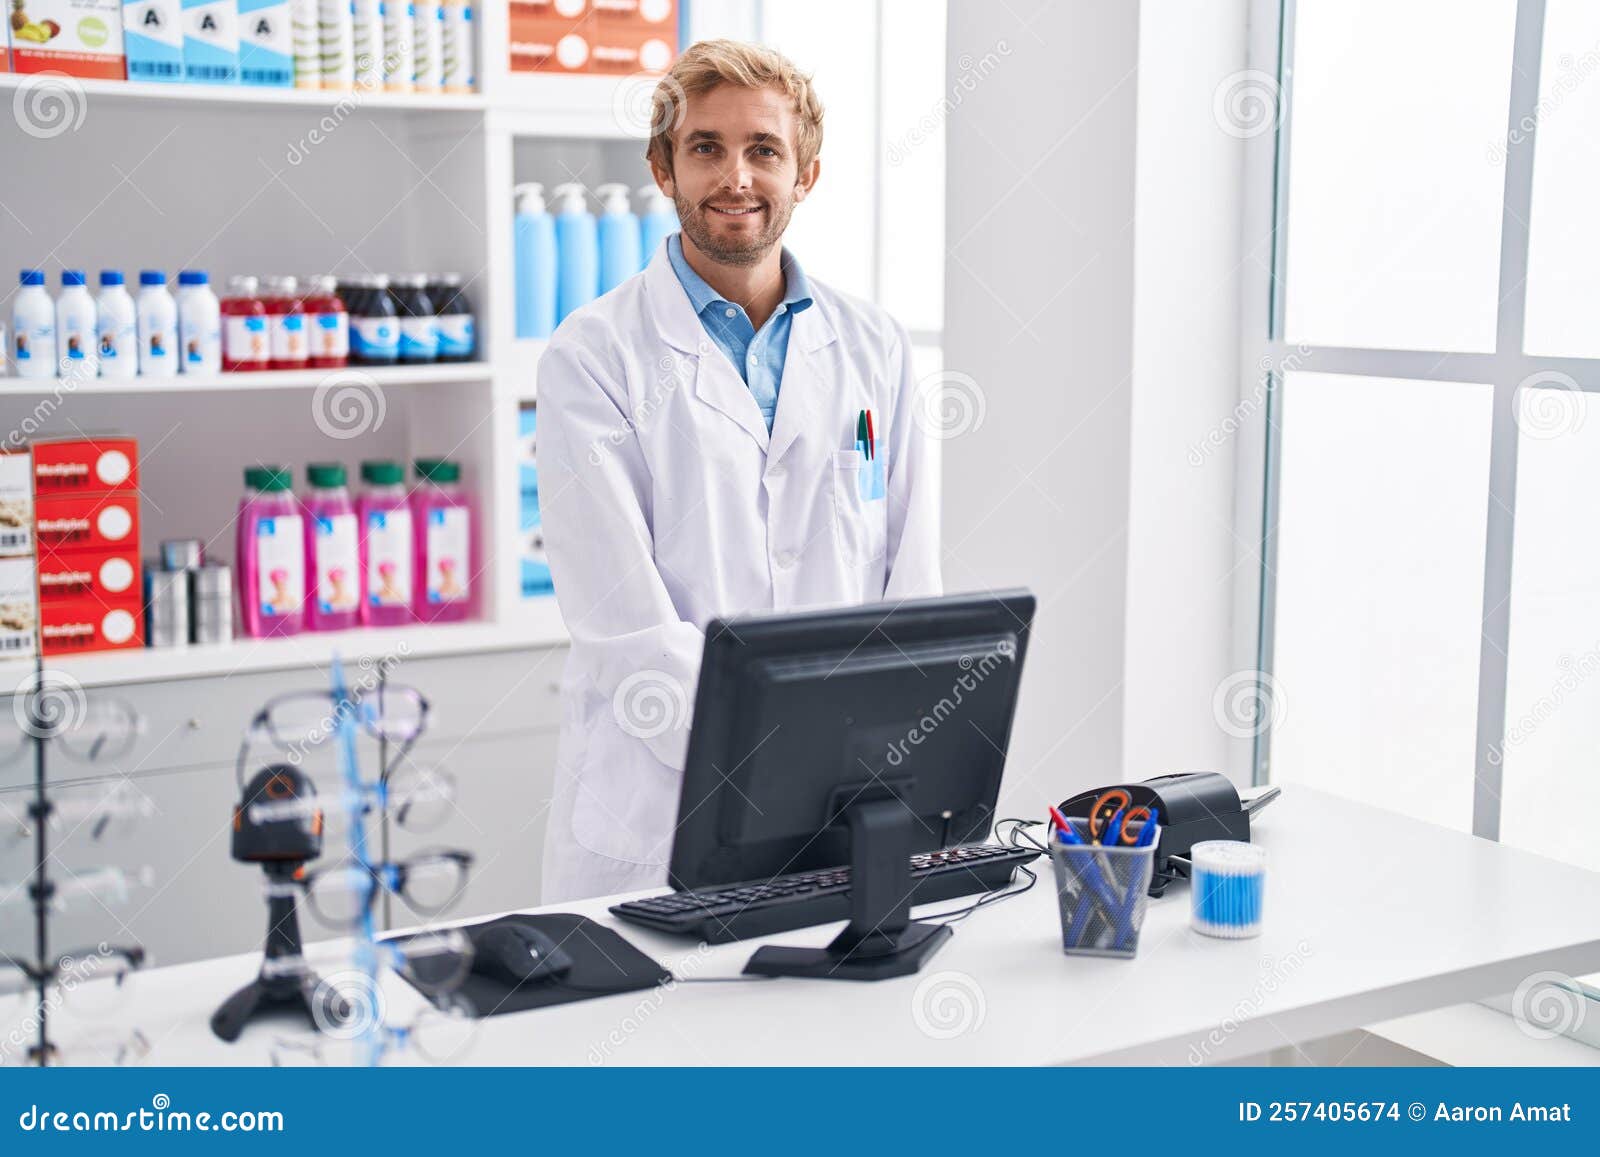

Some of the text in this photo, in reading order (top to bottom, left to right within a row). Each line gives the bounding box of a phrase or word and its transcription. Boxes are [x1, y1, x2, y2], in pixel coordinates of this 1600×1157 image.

[143, 9, 160, 26] A
[201, 14, 217, 31] A
[256, 18, 271, 35] A
